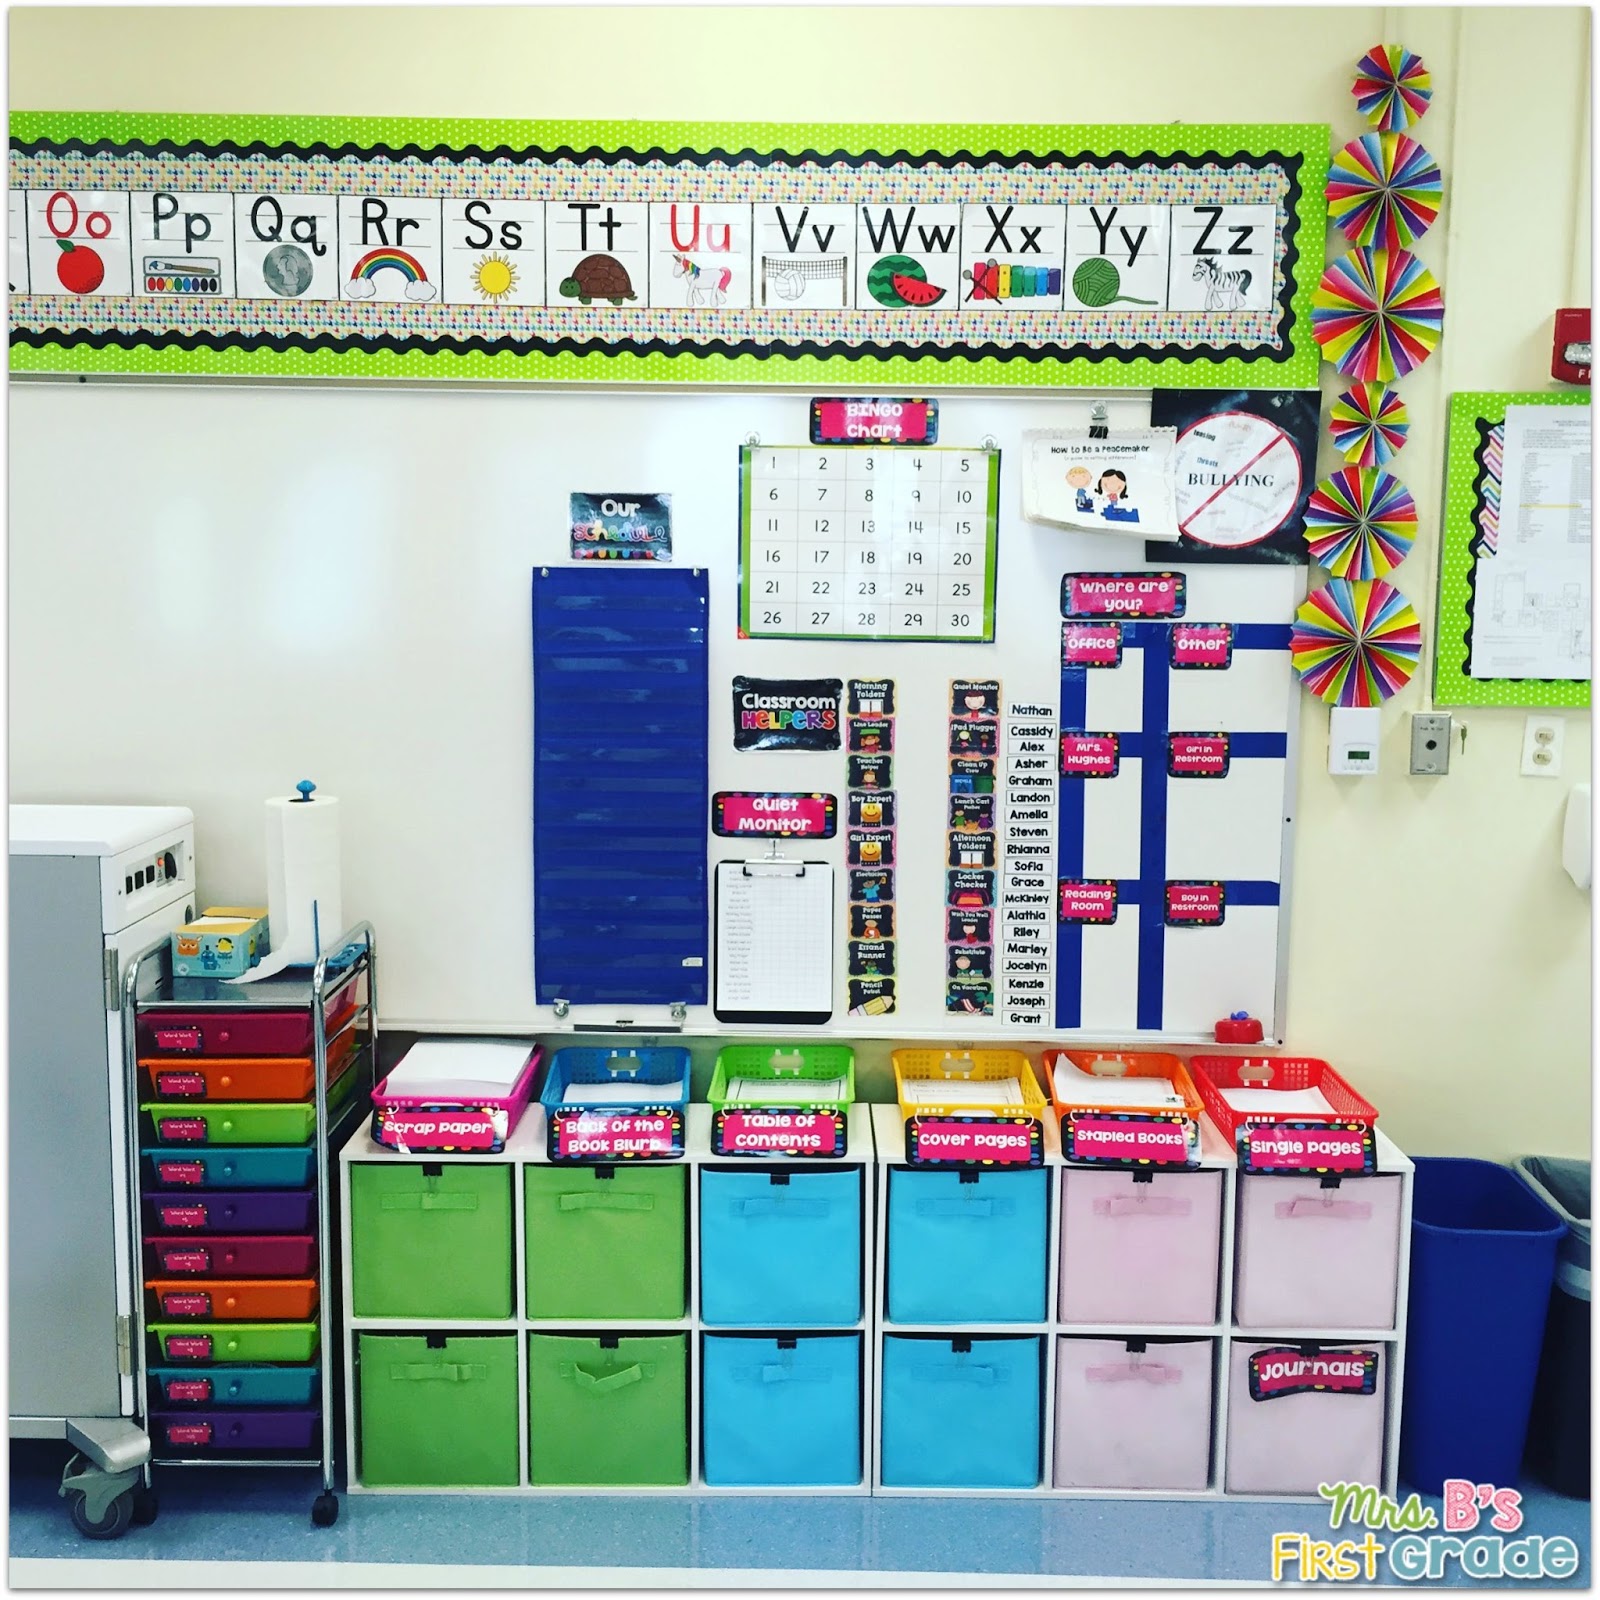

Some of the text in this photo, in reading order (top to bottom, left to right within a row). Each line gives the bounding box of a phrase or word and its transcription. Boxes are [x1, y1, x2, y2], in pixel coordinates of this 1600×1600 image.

[46, 191, 111, 238] Oo
[153, 194, 211, 253] Pp
[251, 195, 326, 256] Qq
[363, 199, 420, 247] Rr
[466, 201, 522, 250] Ss
[568, 204, 621, 251] Tt
[671, 204, 730, 252] Uu
[986, 205, 1041, 253] Xx
[775, 206, 835, 253] Vv
[863, 206, 956, 253] Ww
[1193, 207, 1254, 255] Zz
[1090, 206, 1147, 267] Yy
[847, 403, 903, 417] BINGO
[1102, 445, 1149, 453] Peacemaker
[818, 457, 827, 470] 2
[865, 458, 874, 470] 3
[913, 458, 922, 471] 4
[961, 459, 969, 471] 5
[1188, 473, 1274, 487] BULLYING
[769, 488, 971, 503] 6 7 8 9 10
[601, 499, 641, 517] Our
[768, 519, 971, 534] 11 12 13 14 15
[766, 550, 971, 565] 16 17 18 19 20
[765, 581, 971, 596] 21 22 23 24 25
[1138, 581, 1169, 592] are
[1104, 598, 1143, 612] you?
[764, 612, 969, 626] 26 27 28 29 30
[854, 683, 888, 691] Morning
[742, 693, 836, 709] Classroom
[1012, 705, 1052, 716] Nathan
[1011, 726, 1053, 738] Cassidy
[1020, 742, 1044, 751] Alex
[1076, 743, 1103, 752] Mrs.
[1015, 759, 1048, 769] Asher
[1067, 755, 1111, 765] Hughes
[1175, 755, 1223, 763] Restroom
[1009, 775, 1052, 786] Graham
[1011, 792, 1050, 802] Landon
[752, 798, 798, 811] Quiet
[1010, 810, 1048, 819] Amelia
[739, 817, 812, 831] Monitor
[866, 834, 891, 842] Expert
[1010, 827, 1048, 837] Steven
[1007, 844, 1050, 854] Rhianna
[1015, 861, 1043, 872] Sofia
[1012, 877, 1044, 887] Grace
[1005, 894, 1049, 904] McKinley
[1065, 890, 1112, 900] Reading
[1071, 902, 1104, 911] Room
[1007, 911, 1045, 920] Alathia
[1014, 927, 1039, 938] Riley
[858, 943, 885, 951] Errand
[1007, 944, 1047, 956] Marley
[1006, 960, 1047, 972] Jocelyn
[1009, 978, 1044, 989] Kenzie
[1007, 996, 1045, 1008] Joseph
[1010, 1013, 1041, 1024] Grant
[566, 1120, 608, 1133] Back
[634, 1120, 665, 1132] the
[742, 1115, 791, 1127] Table
[1077, 1130, 1183, 1145] Stapled Books
[568, 1139, 661, 1152] Book Blurb
